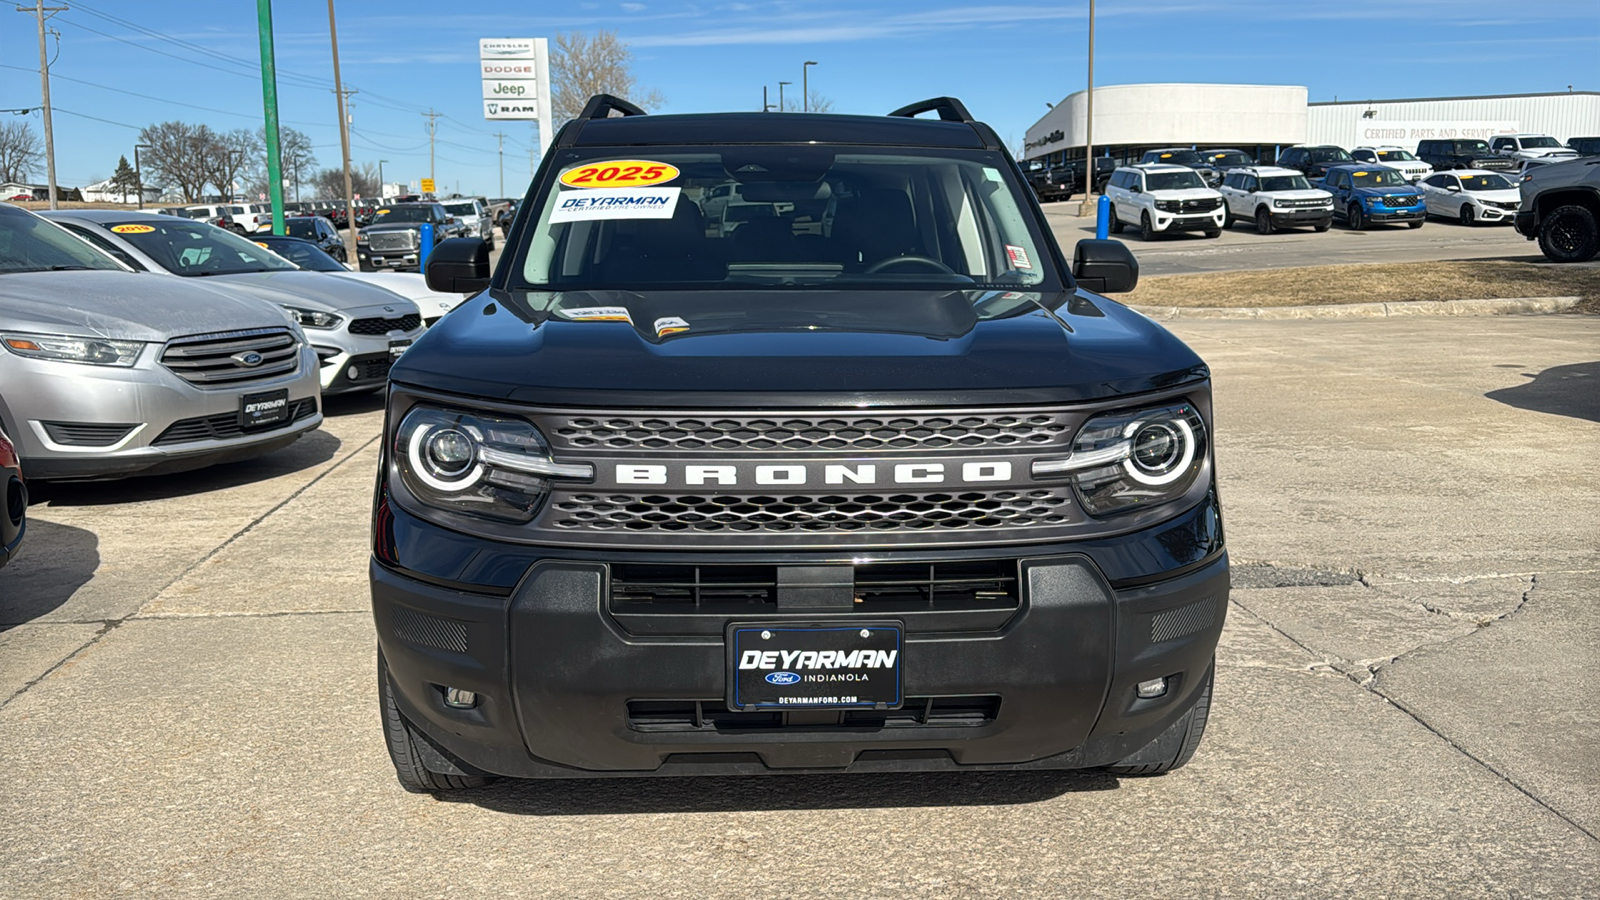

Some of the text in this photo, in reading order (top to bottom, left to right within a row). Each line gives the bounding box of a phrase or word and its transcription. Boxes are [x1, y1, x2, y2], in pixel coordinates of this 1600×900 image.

[493, 82, 525, 96] Jeep
[1364, 128, 1495, 139] CERTIFIED PARTS AND SERVICE
[571, 166, 667, 183] 2025
[561, 196, 670, 208] DEYARMAN
[245, 398, 286, 413] DEYARMAN
[615, 461, 1012, 485] BRONCO
[738, 650, 898, 669] DEYARMAN
[770, 673, 869, 683] Ford INDIANOLA
[779, 696, 857, 704] DEYARMANFORD.COM
